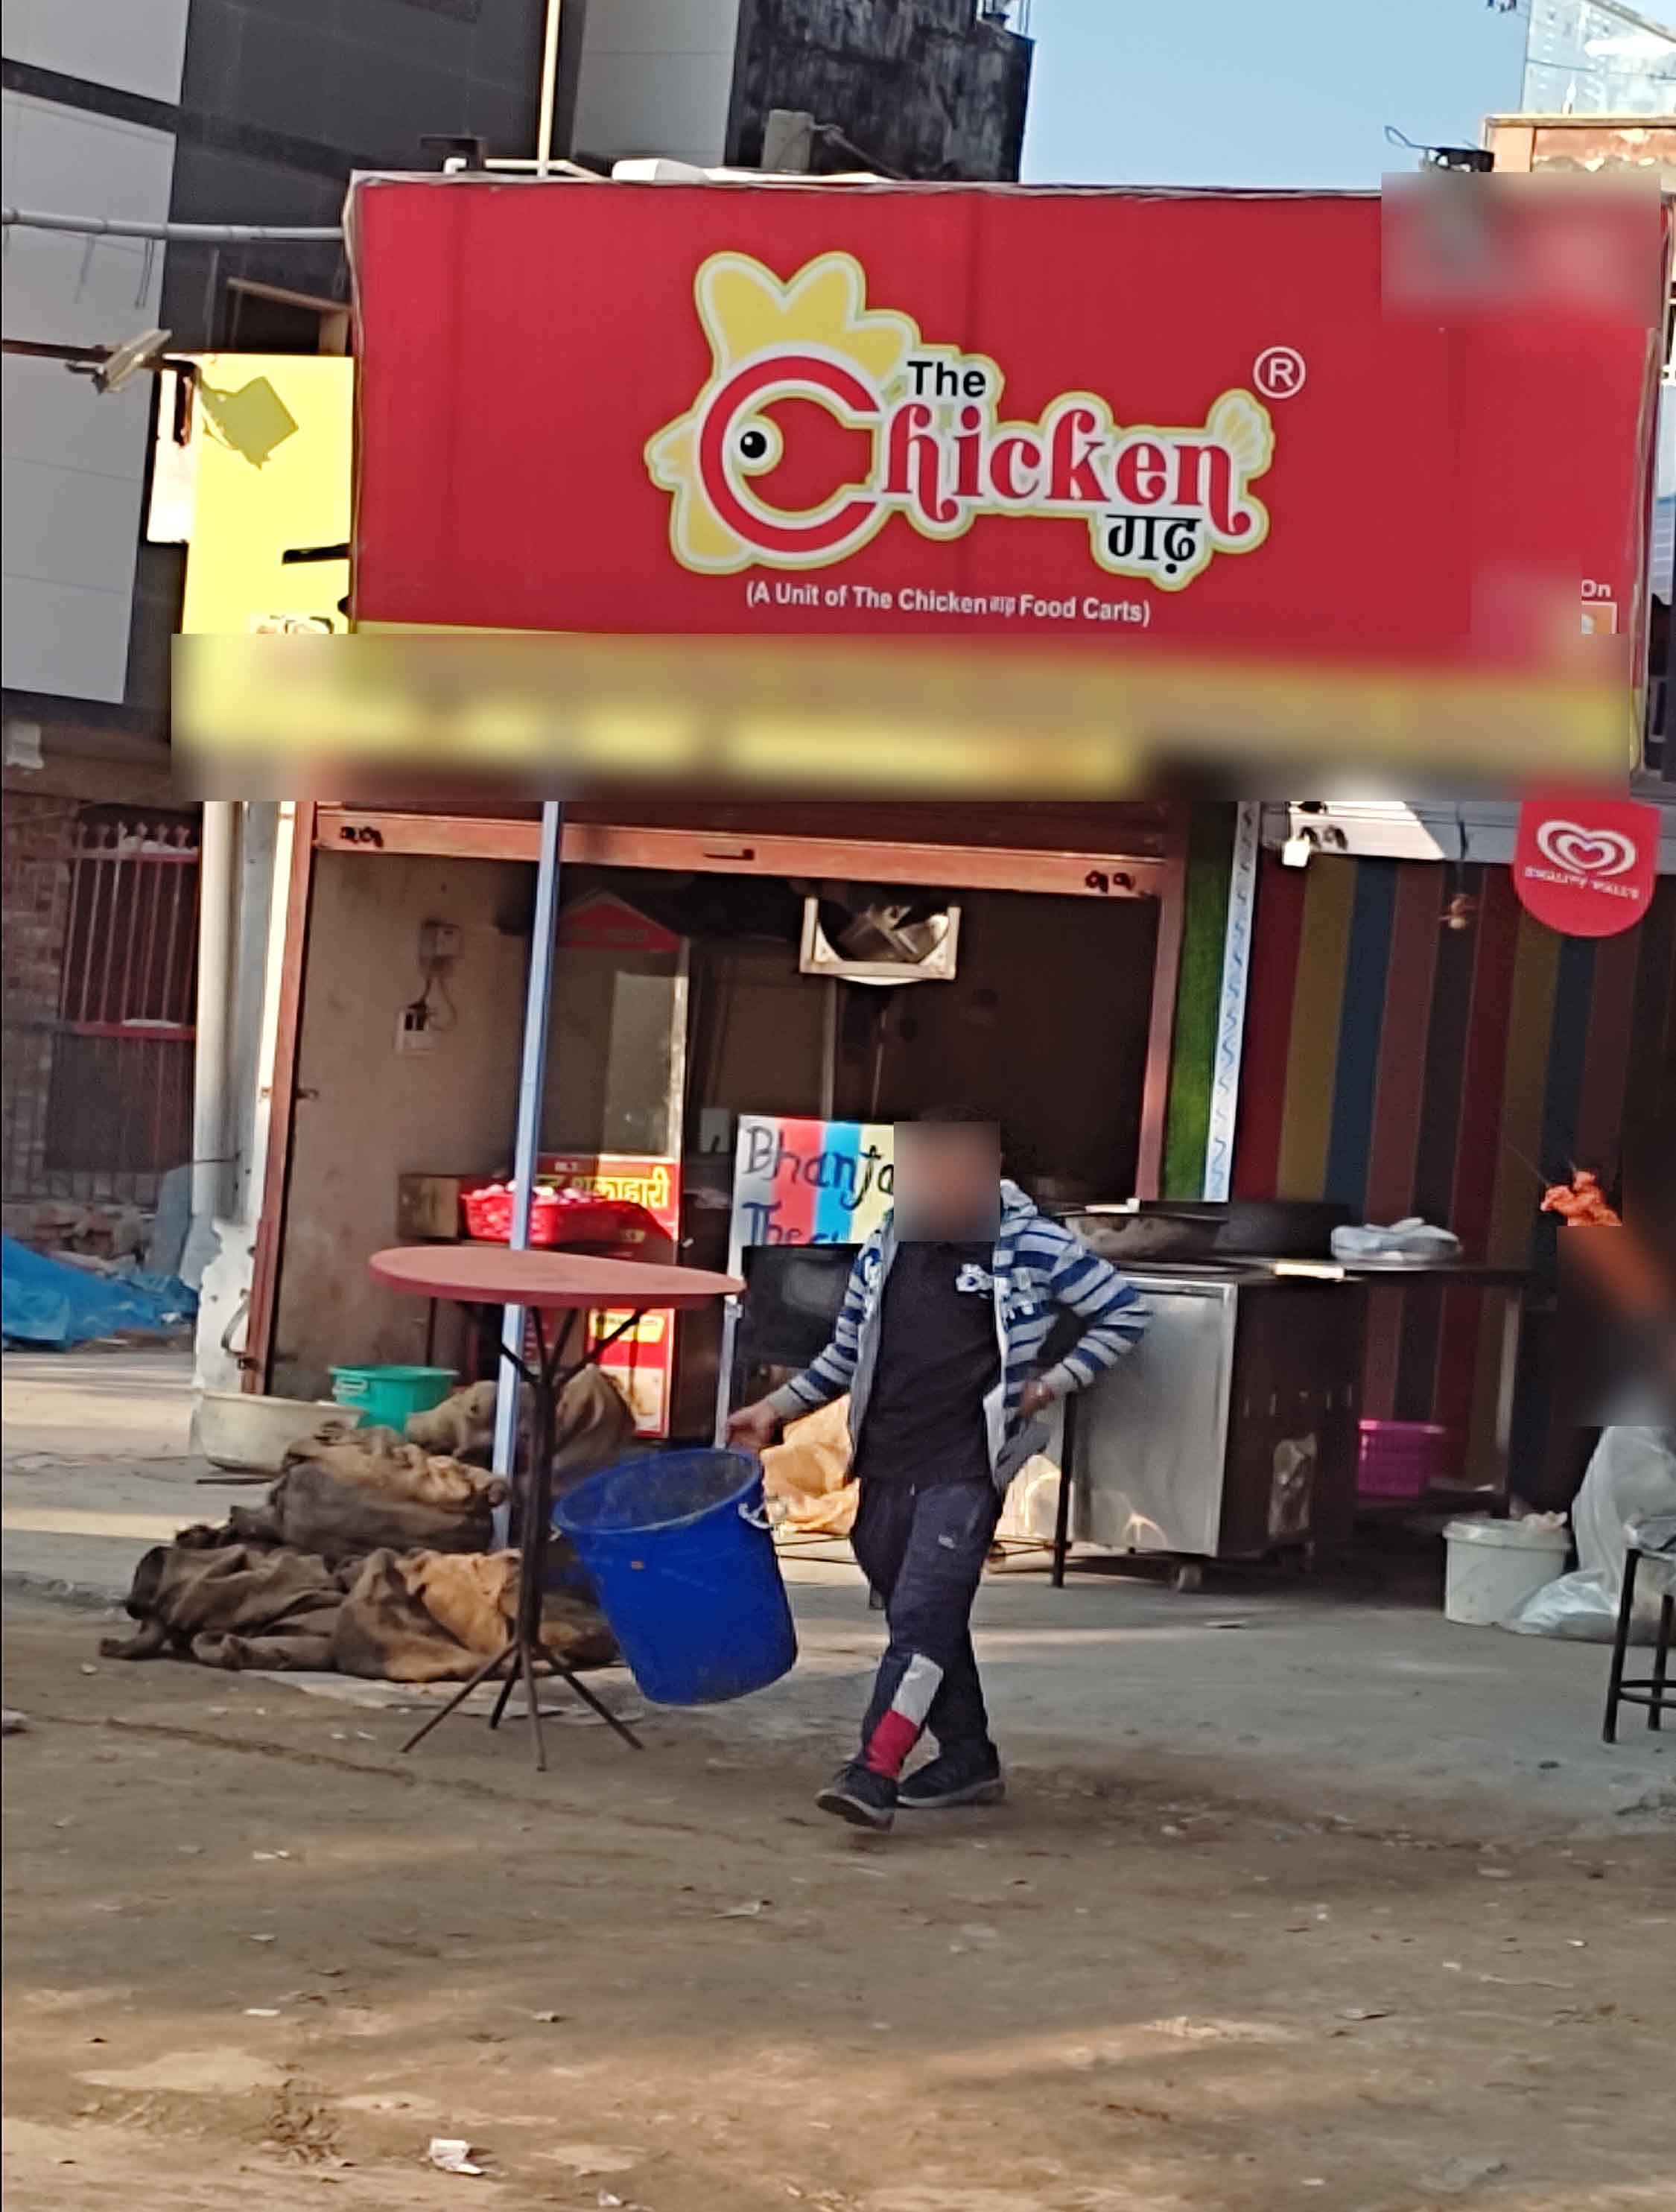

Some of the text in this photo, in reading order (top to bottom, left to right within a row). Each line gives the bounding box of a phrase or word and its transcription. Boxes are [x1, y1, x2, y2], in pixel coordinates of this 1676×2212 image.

[907, 360, 986, 397] The
[699, 355, 1251, 554] Chicken
[1106, 515, 1202, 573] गढ़
[746, 581, 771, 608] (A
[775, 582, 819, 606] Unit
[824, 585, 848, 607] of
[852, 586, 893, 609] The
[898, 588, 988, 614] Chicken
[1020, 594, 1076, 618] Food
[1082, 597, 1151, 627] Carts)
